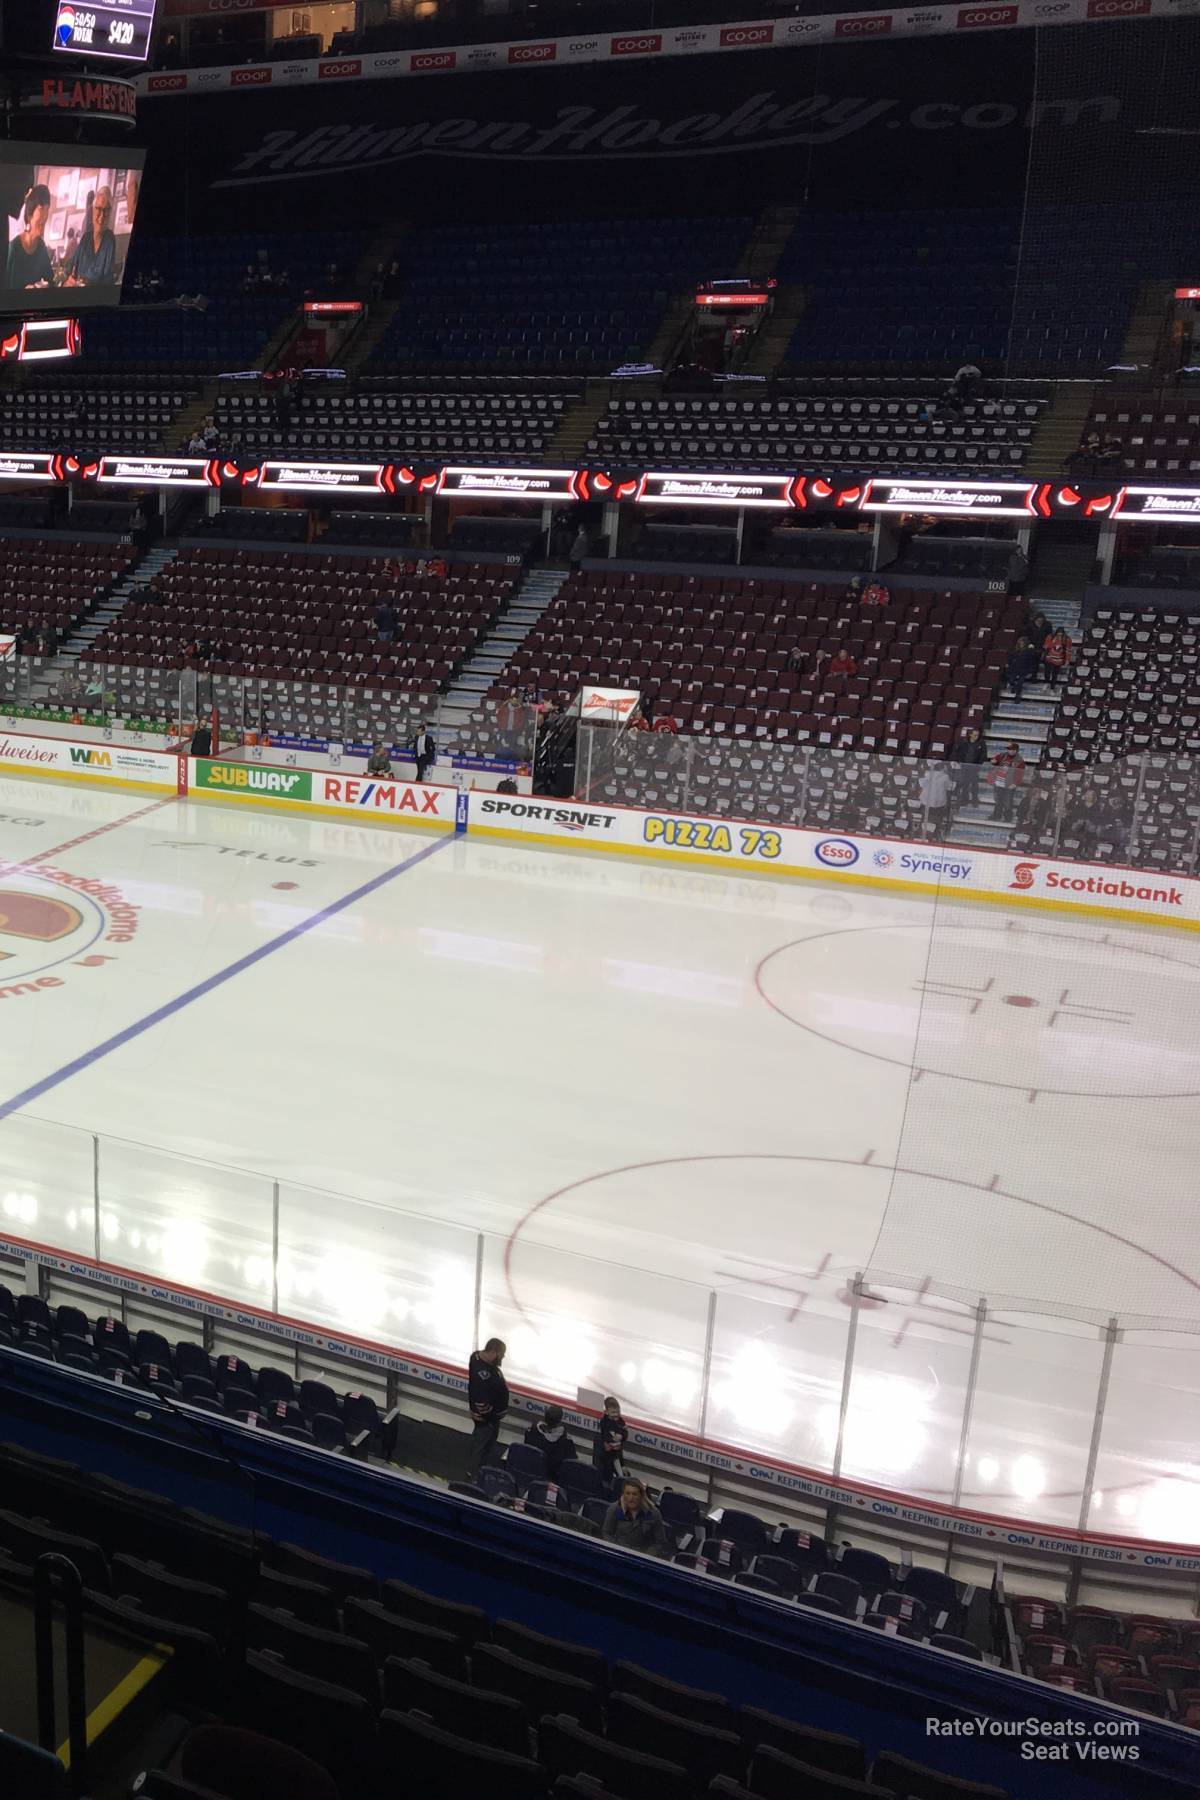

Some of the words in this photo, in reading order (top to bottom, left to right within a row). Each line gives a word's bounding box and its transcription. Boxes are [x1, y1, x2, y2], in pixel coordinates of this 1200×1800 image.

[75, 12, 97, 28] 50/50
[842, 20, 886, 32] CO-OP
[964, 11, 1011, 23] CO-OP
[73, 26, 93, 43] TOTAL
[108, 19, 135, 44] $420
[726, 30, 768, 42] CO-OP
[513, 48, 552, 60] CO-OP
[617, 39, 657, 50] CO-OP
[323, 64, 358, 76] CO-OP
[416, 55, 450, 67] CO-OP
[42, 79, 115, 111] FLAMES
[459, 474, 550, 490] HitmenHockey.com
[661, 481, 763, 498] HitmenHockey.com
[888, 487, 1002, 506] HitmenHockey.com
[506, 555, 521, 563] 109
[988, 581, 1006, 591] 108
[69, 747, 112, 766] WM
[208, 766, 300, 793] SUBWAY
[324, 778, 441, 815] RE/MAX
[481, 799, 616, 829] SPORTSNET
[644, 817, 732, 852] PIZZA
[740, 828, 782, 859] 73
[218, 845, 327, 869] TELUS
[821, 845, 853, 860] Esso
[900, 854, 972, 880] Synergy
[1046, 871, 1184, 906] Scotiabank
[31, 863, 143, 945] Saddledome
[237, 1314, 255, 1325] OPA!
[257, 1318, 283, 1335] KEEPING
[293, 1328, 313, 1344] FRESH
[634, 1434, 658, 1446] OPA!
[661, 1441, 693, 1458] KEEPING
[705, 1452, 731, 1469] FRESH
[750, 1468, 774, 1480] OPA!
[777, 1474, 811, 1492] KEEPING
[825, 1487, 853, 1504] FRESH
[872, 1502, 898, 1516] OPA!
[901, 1510, 939, 1527] KEEPING
[953, 1520, 982, 1536] FRESH
[1008, 1533, 1035, 1545] OPA!
[1038, 1540, 1077, 1555] KEEPING
[1093, 1547, 1122, 1561] FRESH
[1144, 1555, 1172, 1566] OPA!
